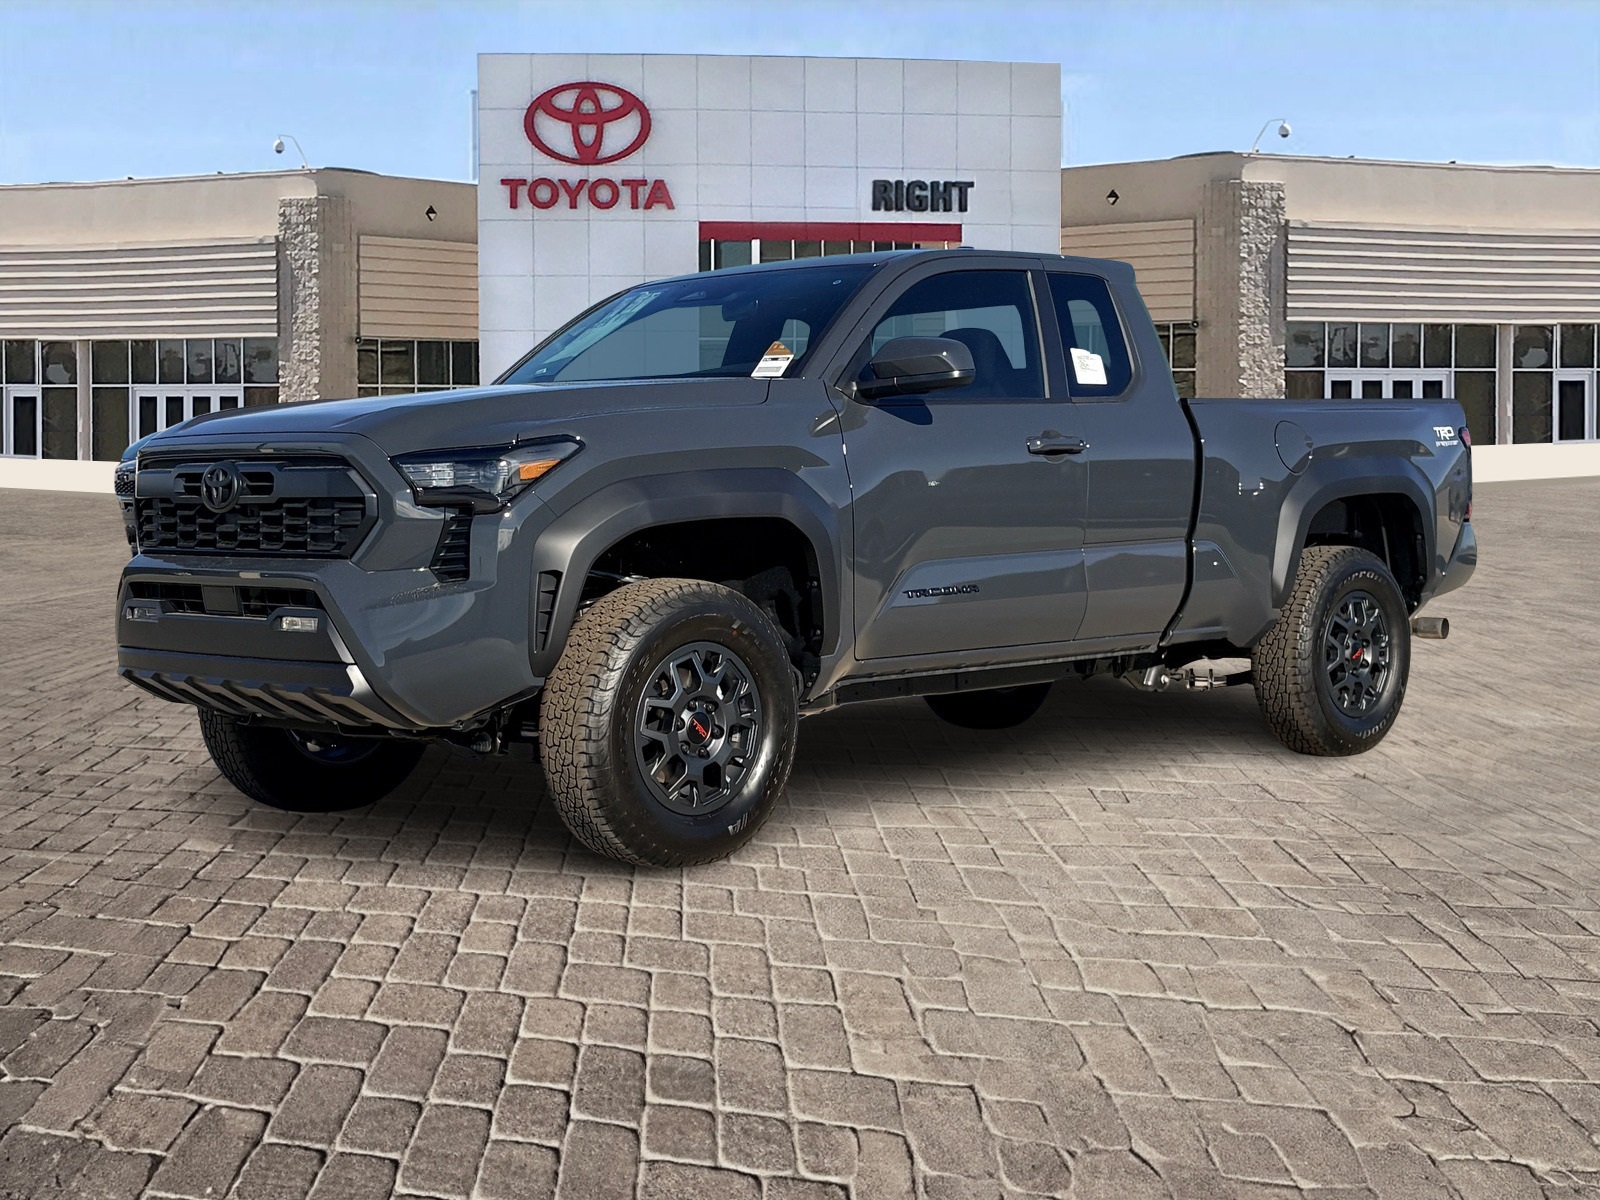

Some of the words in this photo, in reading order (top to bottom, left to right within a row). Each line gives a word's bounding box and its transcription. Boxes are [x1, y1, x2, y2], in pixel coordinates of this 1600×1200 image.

[500, 178, 675, 210] TOYOTA
[872, 179, 975, 213] RIGHT
[1432, 426, 1455, 441] TRD
[902, 584, 980, 599] TACOMA
